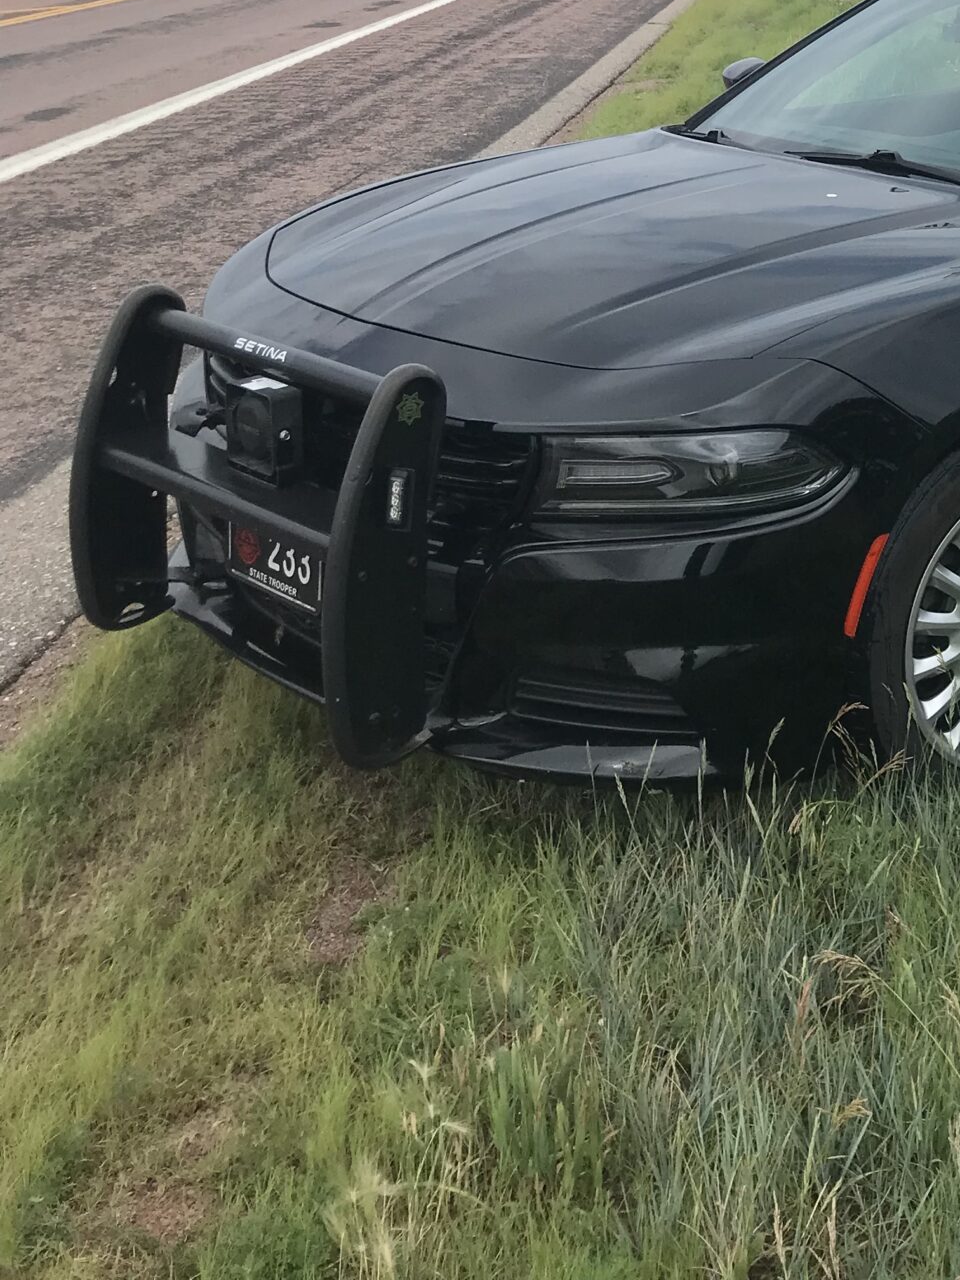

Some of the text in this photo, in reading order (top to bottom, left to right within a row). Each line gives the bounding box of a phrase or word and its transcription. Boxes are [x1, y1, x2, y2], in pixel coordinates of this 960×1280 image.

[234, 337, 287, 362] SETINA
[249, 567, 297, 596] STATE TROOPER
